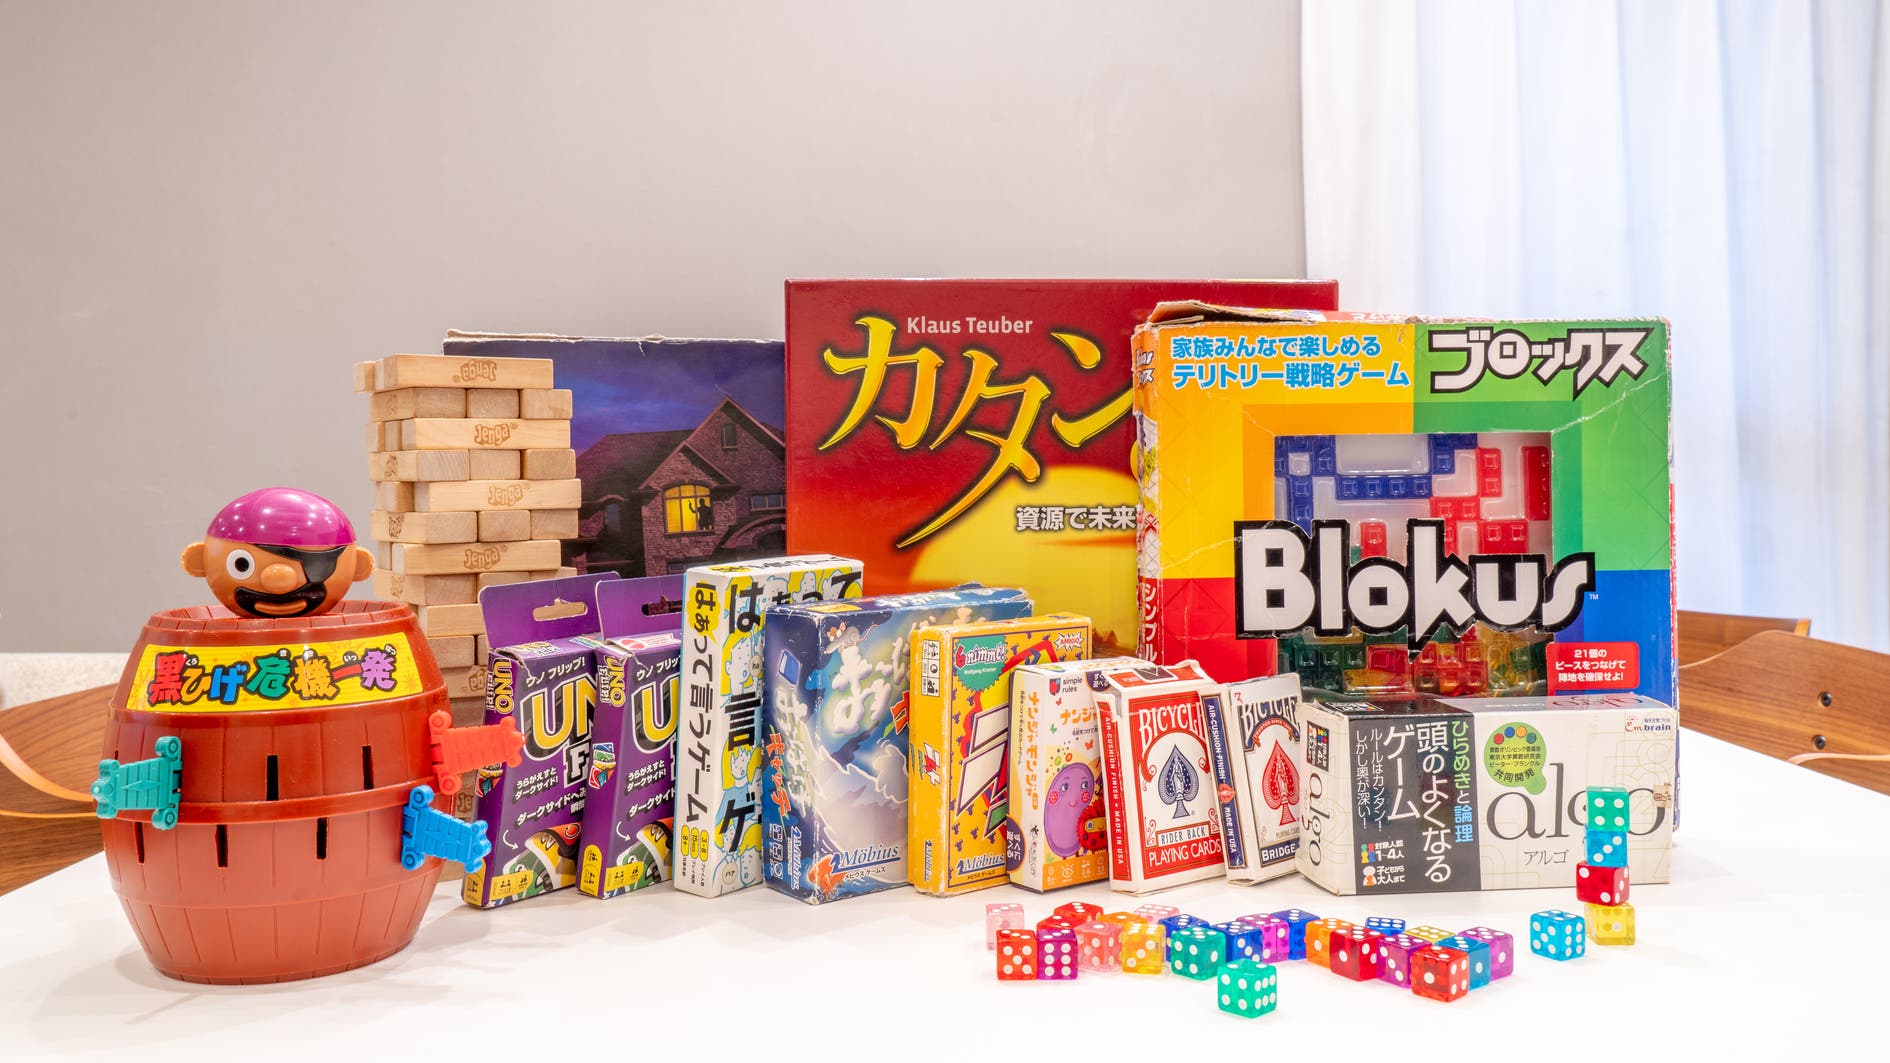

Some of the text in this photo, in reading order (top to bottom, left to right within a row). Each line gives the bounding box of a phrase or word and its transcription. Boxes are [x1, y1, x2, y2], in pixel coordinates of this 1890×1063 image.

[906, 316, 1033, 334] Klaus Teuber
[1171, 335, 1382, 359] 家族みんなで楽しめる
[460, 359, 498, 382] Jenga
[1427, 326, 1656, 401] ブロックス
[1172, 362, 1411, 389] テリトリー戦略ゲーム
[473, 423, 511, 446] Jenga
[818, 316, 1134, 549] カタン
[487, 484, 523, 507] Jenga
[463, 547, 501, 570] Jenga
[1233, 518, 1597, 663] Blokus
[1060, 637, 1080, 645] AMIGO
[1555, 660, 1627, 671] ピースをつなげて
[1574, 649, 1608, 659] 21個の
[150, 648, 398, 706] 黒ひげ危機一発
[548, 655, 586, 680] フリップ!
[493, 658, 515, 715] UNO
[604, 656, 626, 708] UNO
[1063, 677, 1083, 686] simple
[684, 582, 717, 823] はぁって言うゲーム
[1644, 723, 1672, 731] brain
[1025, 691, 1040, 797] ナンジャモンジャ
[515, 766, 557, 789] うらがえすと
[626, 769, 667, 792] ダークサイド!
[628, 759, 665, 781] うらがえすと
[766, 733, 791, 817] キャッチ
[1383, 724, 1421, 821] ゲーム
[1452, 720, 1474, 842] ひらめきと論理
[1494, 767, 1536, 783] 共同開発
[514, 775, 559, 800] ダークサイド!
[1111, 771, 1119, 800] FINISH
[1416, 721, 1452, 884] 頭のよくなる
[1114, 810, 1122, 834] MADE
[1225, 807, 1234, 827] MADE
[1302, 772, 1330, 867] algo
[1116, 836, 1123, 845] IN
[1160, 827, 1206, 845] RIDER BACK
[1374, 840, 1404, 850] 対象人数
[841, 845, 899, 867] Möbius
[963, 854, 1005, 871] Möbius
[1117, 847, 1125, 865] USA
[1149, 838, 1222, 867] PLAYING CARDS
[1261, 844, 1296, 863] BRIDGE
[1523, 849, 1569, 866] アルゴ
[1377, 874, 1406, 885] 大人まで
